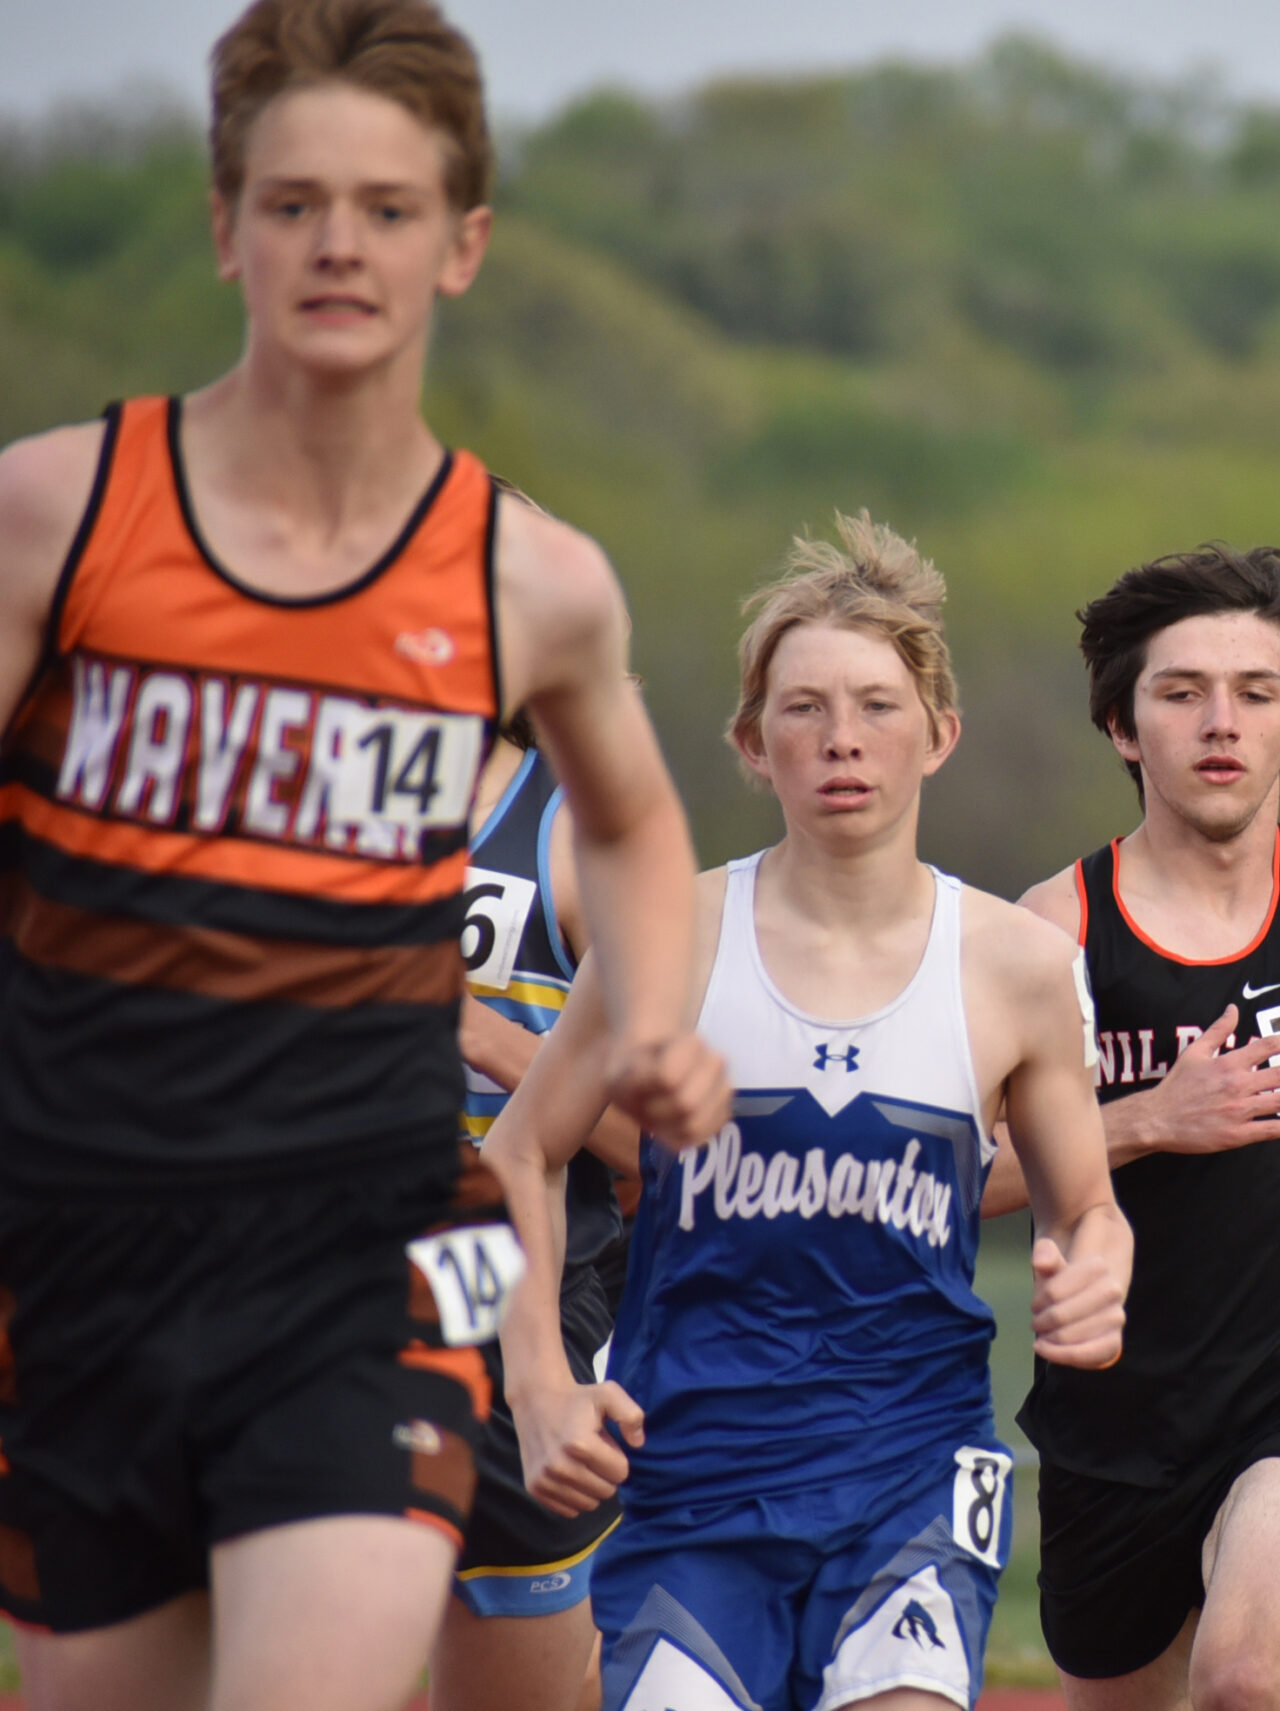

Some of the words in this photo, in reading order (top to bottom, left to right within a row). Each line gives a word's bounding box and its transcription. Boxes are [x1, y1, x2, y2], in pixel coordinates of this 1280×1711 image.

[56, 655, 421, 863] WAVER
[357, 722, 444, 814] 14
[460, 882, 505, 973] 6
[678, 1121, 951, 1248] Pleasanton
[437, 1242, 503, 1330] 14
[967, 1456, 999, 1554] 8
